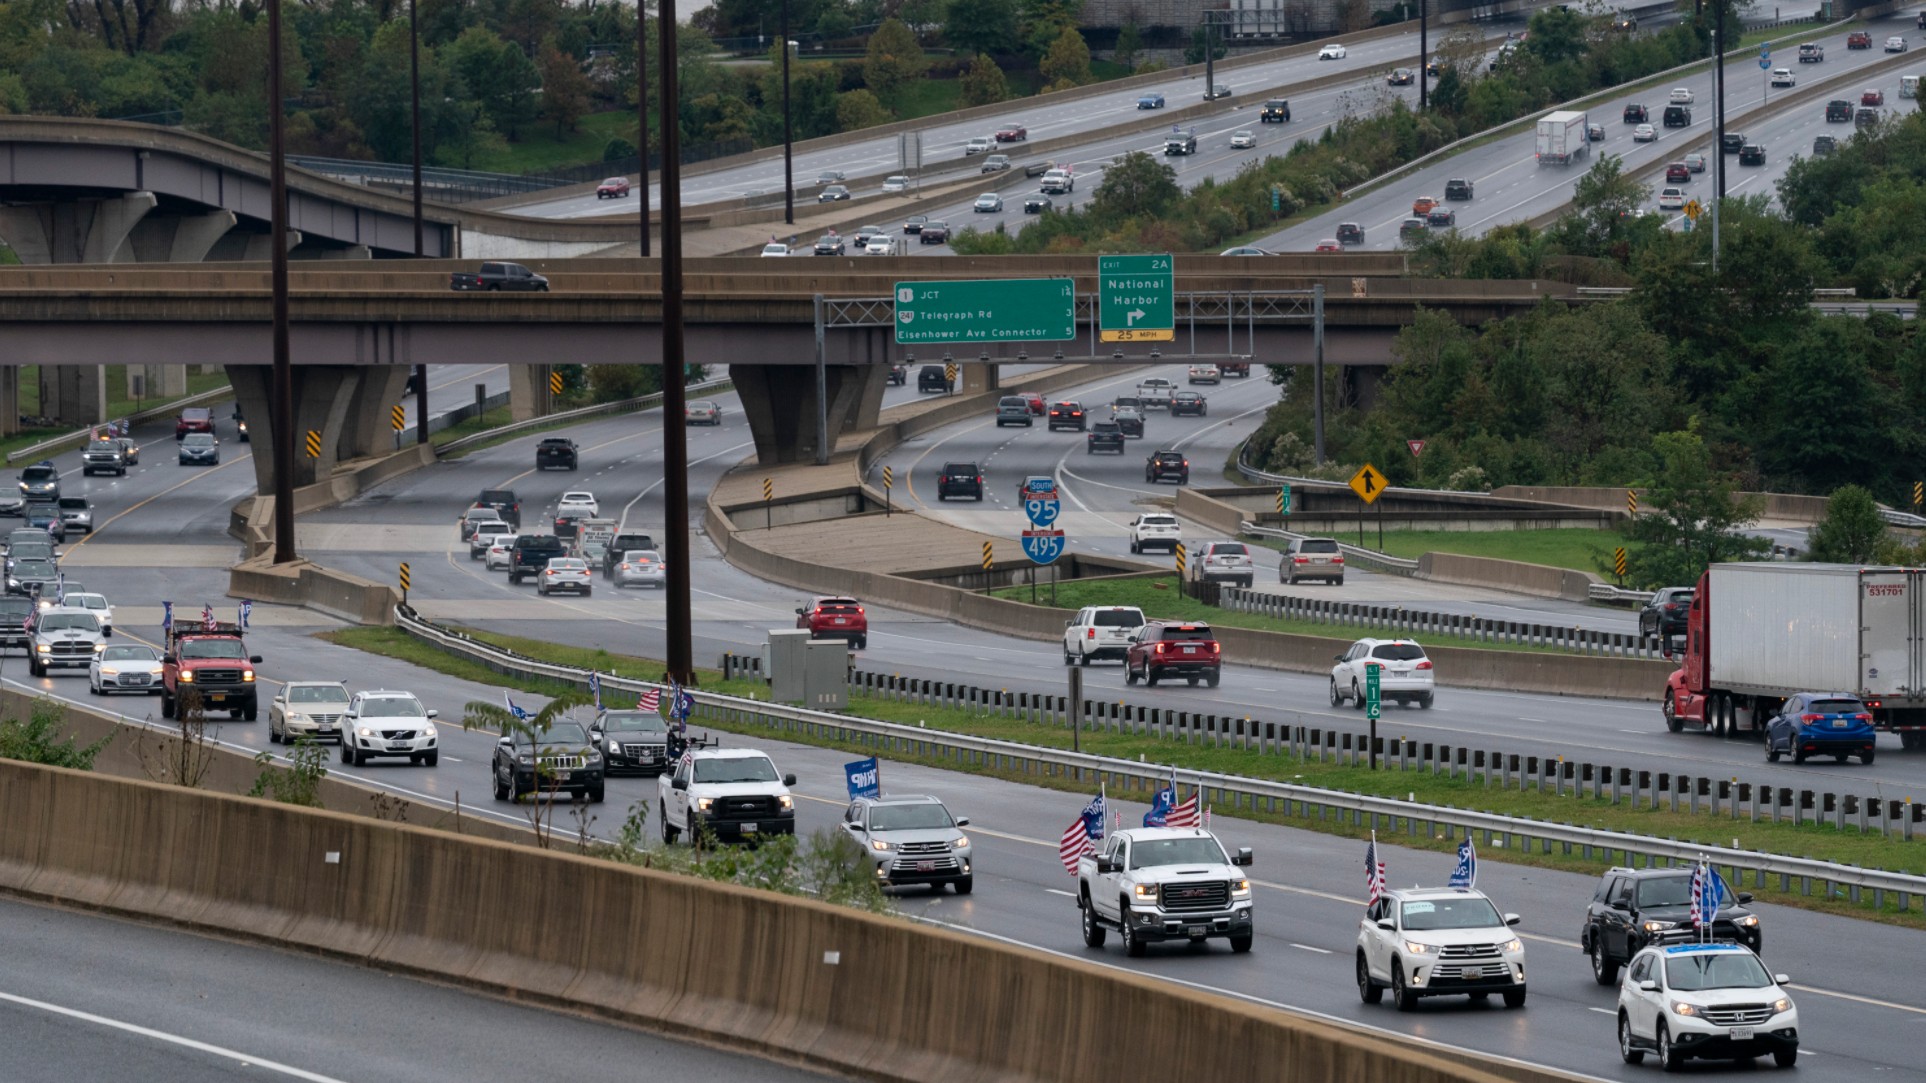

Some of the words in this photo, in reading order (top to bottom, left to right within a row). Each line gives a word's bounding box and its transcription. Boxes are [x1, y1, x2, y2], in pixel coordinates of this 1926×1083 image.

[1103, 261, 1120, 269] EXIT
[1151, 259, 1168, 269] 2A
[1108, 279, 1164, 289] National
[920, 291, 940, 300] JCT
[1114, 295, 1158, 305] Harbor
[900, 312, 914, 320] 241
[920, 311, 974, 322] Telegraph
[978, 310, 992, 319] Rd
[1065, 308, 1072, 317] 3
[898, 330, 960, 339] Eisenhower
[966, 329, 986, 338] Ave
[991, 328, 1047, 337] Connector
[1065, 327, 1073, 336] 5
[1117, 330, 1133, 340] 25
[1031, 481, 1053, 490] SOUTH
[1028, 500, 1057, 520] 95
[1029, 537, 1058, 557] 495
[1371, 686, 1375, 700] 1
